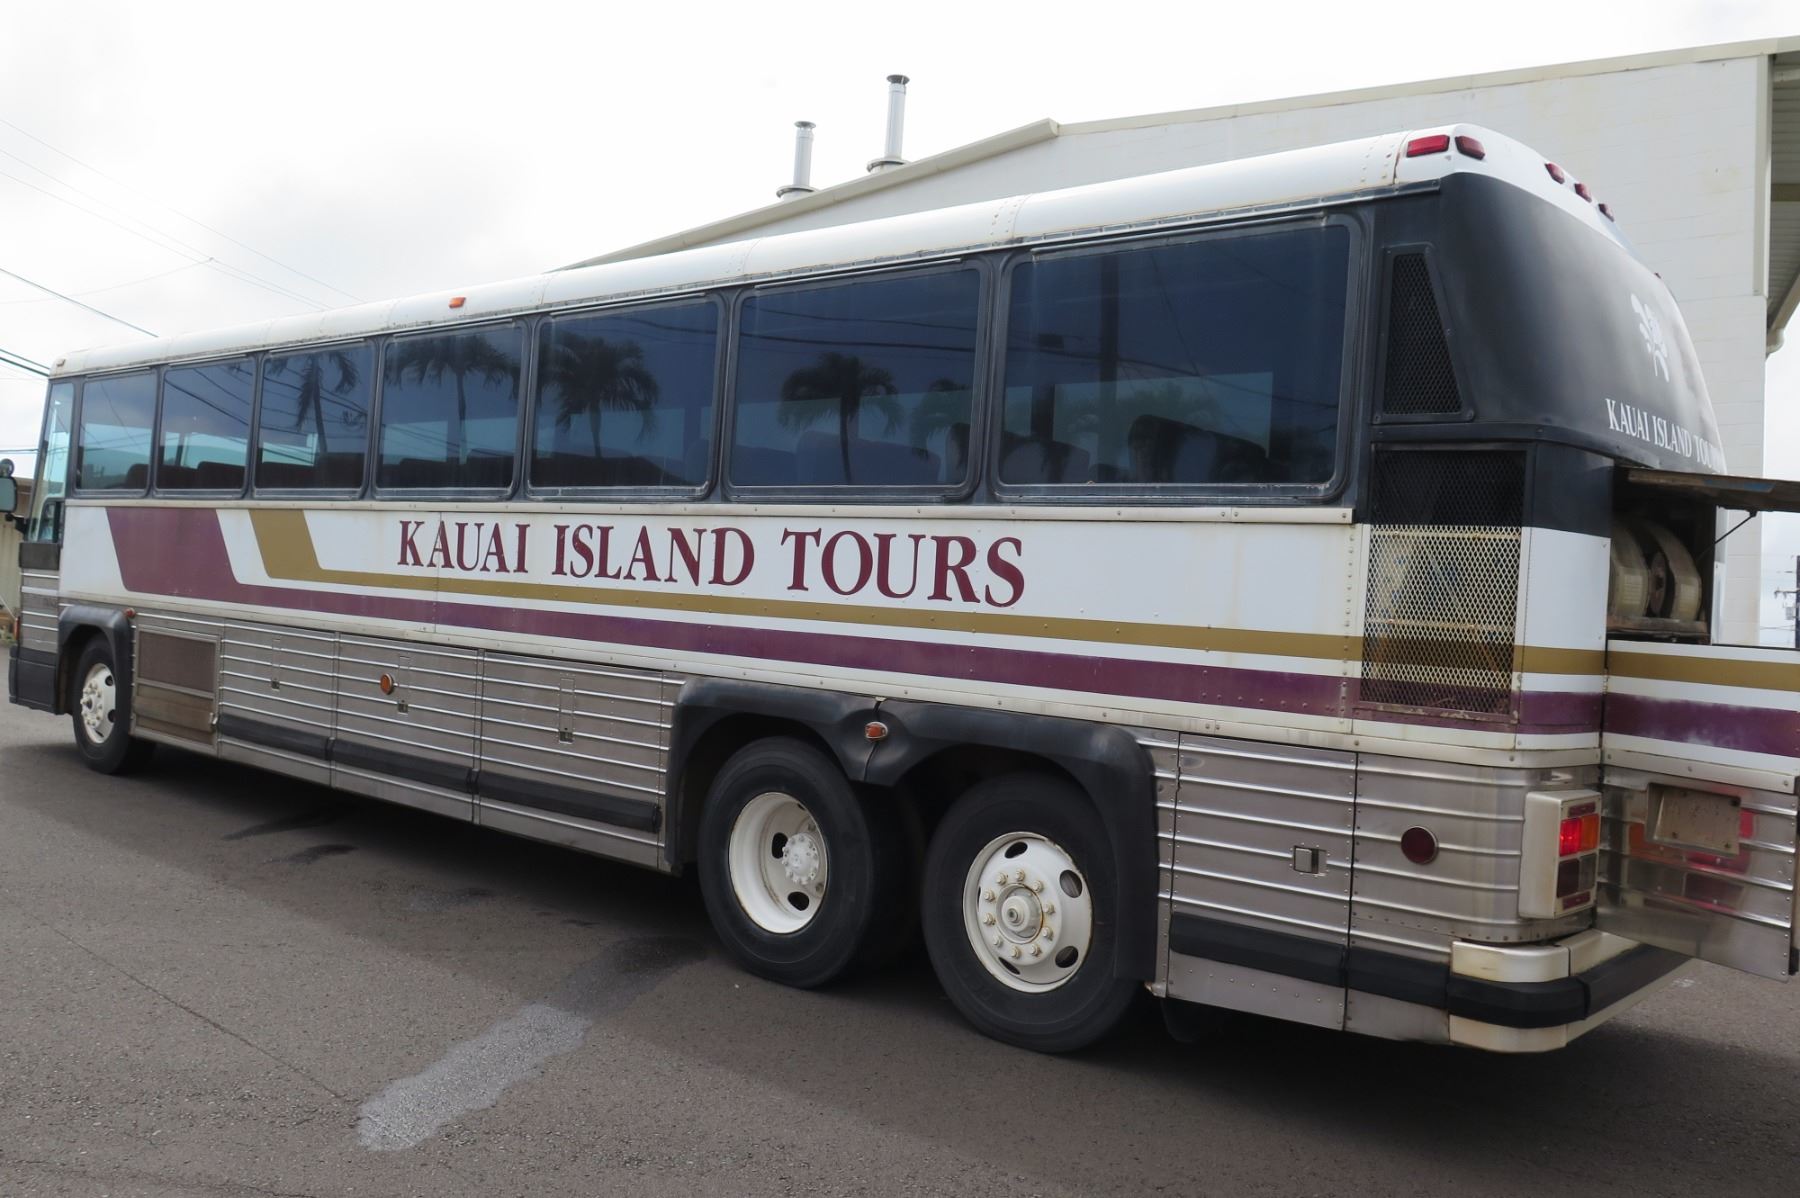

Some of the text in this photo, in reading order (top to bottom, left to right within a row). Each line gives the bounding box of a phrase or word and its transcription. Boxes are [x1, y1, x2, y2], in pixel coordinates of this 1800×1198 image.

[1605, 398, 1650, 442] KAUAI
[1652, 415, 1692, 458] ISLAND
[398, 520, 1025, 609] KAUAI ISLAND TOURS
